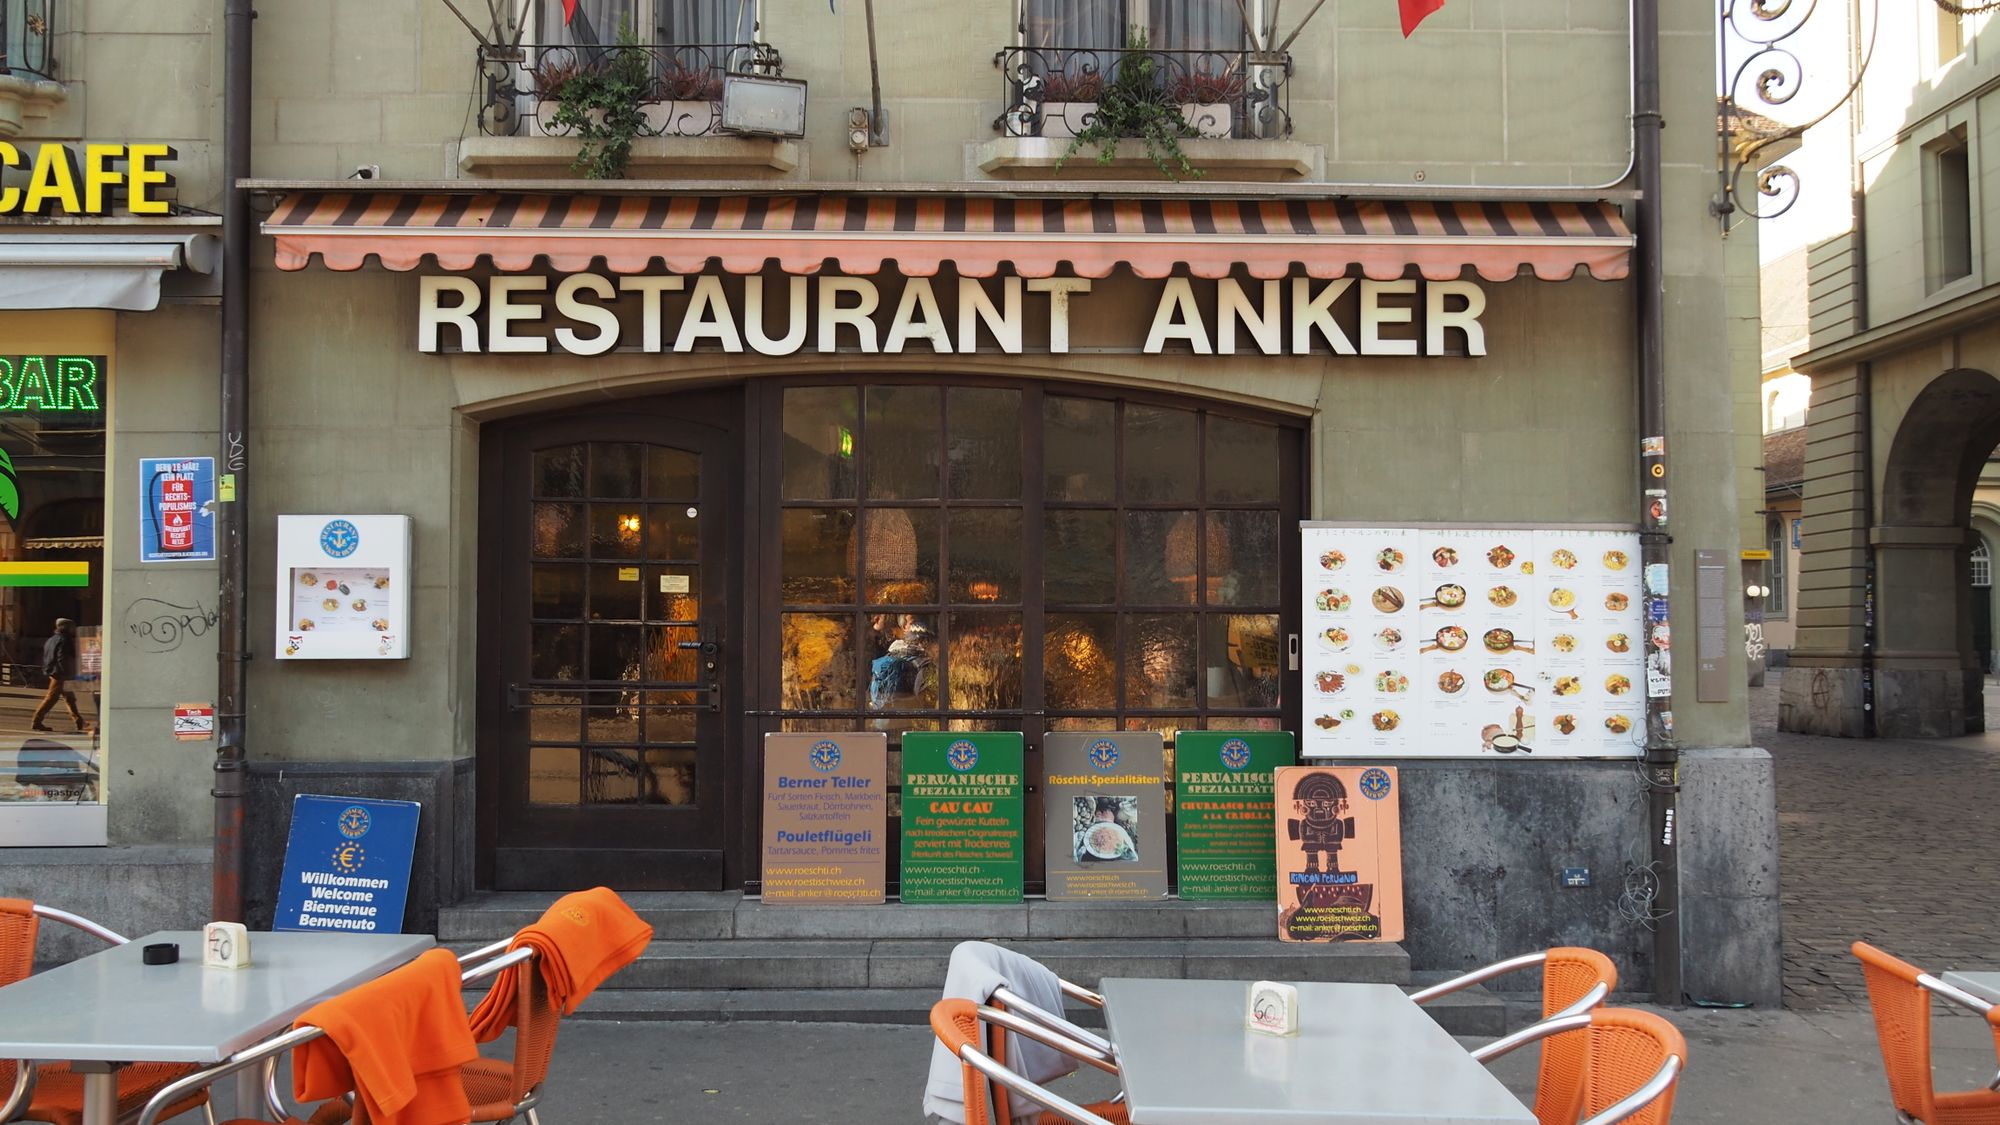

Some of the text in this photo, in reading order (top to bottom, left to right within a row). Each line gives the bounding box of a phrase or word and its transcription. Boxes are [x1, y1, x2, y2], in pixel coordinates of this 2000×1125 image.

[418, 273, 1487, 356] RESTAURANT ANKER
[778, 777, 871, 788] Berner Teller
[907, 774, 1019, 785] PERUANISCHE
[1048, 774, 1160, 787] Röschti-Spezialitäten
[913, 784, 1011, 795] SPEZIALITÄTEN
[768, 792, 785, 800] Fünf
[789, 792, 813, 800] Sorten
[930, 802, 993, 813] CAU CAU
[1181, 802, 1243, 810] CHURRASCO
[916, 816, 1009, 827] Fein gewürzte Kutteln
[777, 830, 872, 845] Pouletflügeli
[906, 829, 923, 837] nach
[914, 839, 1010, 848] serviert mit Trockenreis
[821, 846, 857, 855] Pommes
[860, 846, 880, 855] frites
[766, 866, 842, 875] www.roeschti.ch
[905, 866, 980, 874] www.roeschti.ch
[1182, 862, 1256, 871] www.roeschti.ch
[301, 872, 389, 889] Willkommen
[766, 877, 865, 886] www.roestischweiz.ch
[905, 877, 1004, 886] www.roestischweiz.ch
[311, 886, 373, 902] Welcome
[302, 900, 377, 917] Bienvenue
[1304, 906, 1361, 914] www.roeschti.ch
[299, 914, 376, 931] Benvenuto
[1295, 915, 1370, 923] www.roestischweiz.ch
